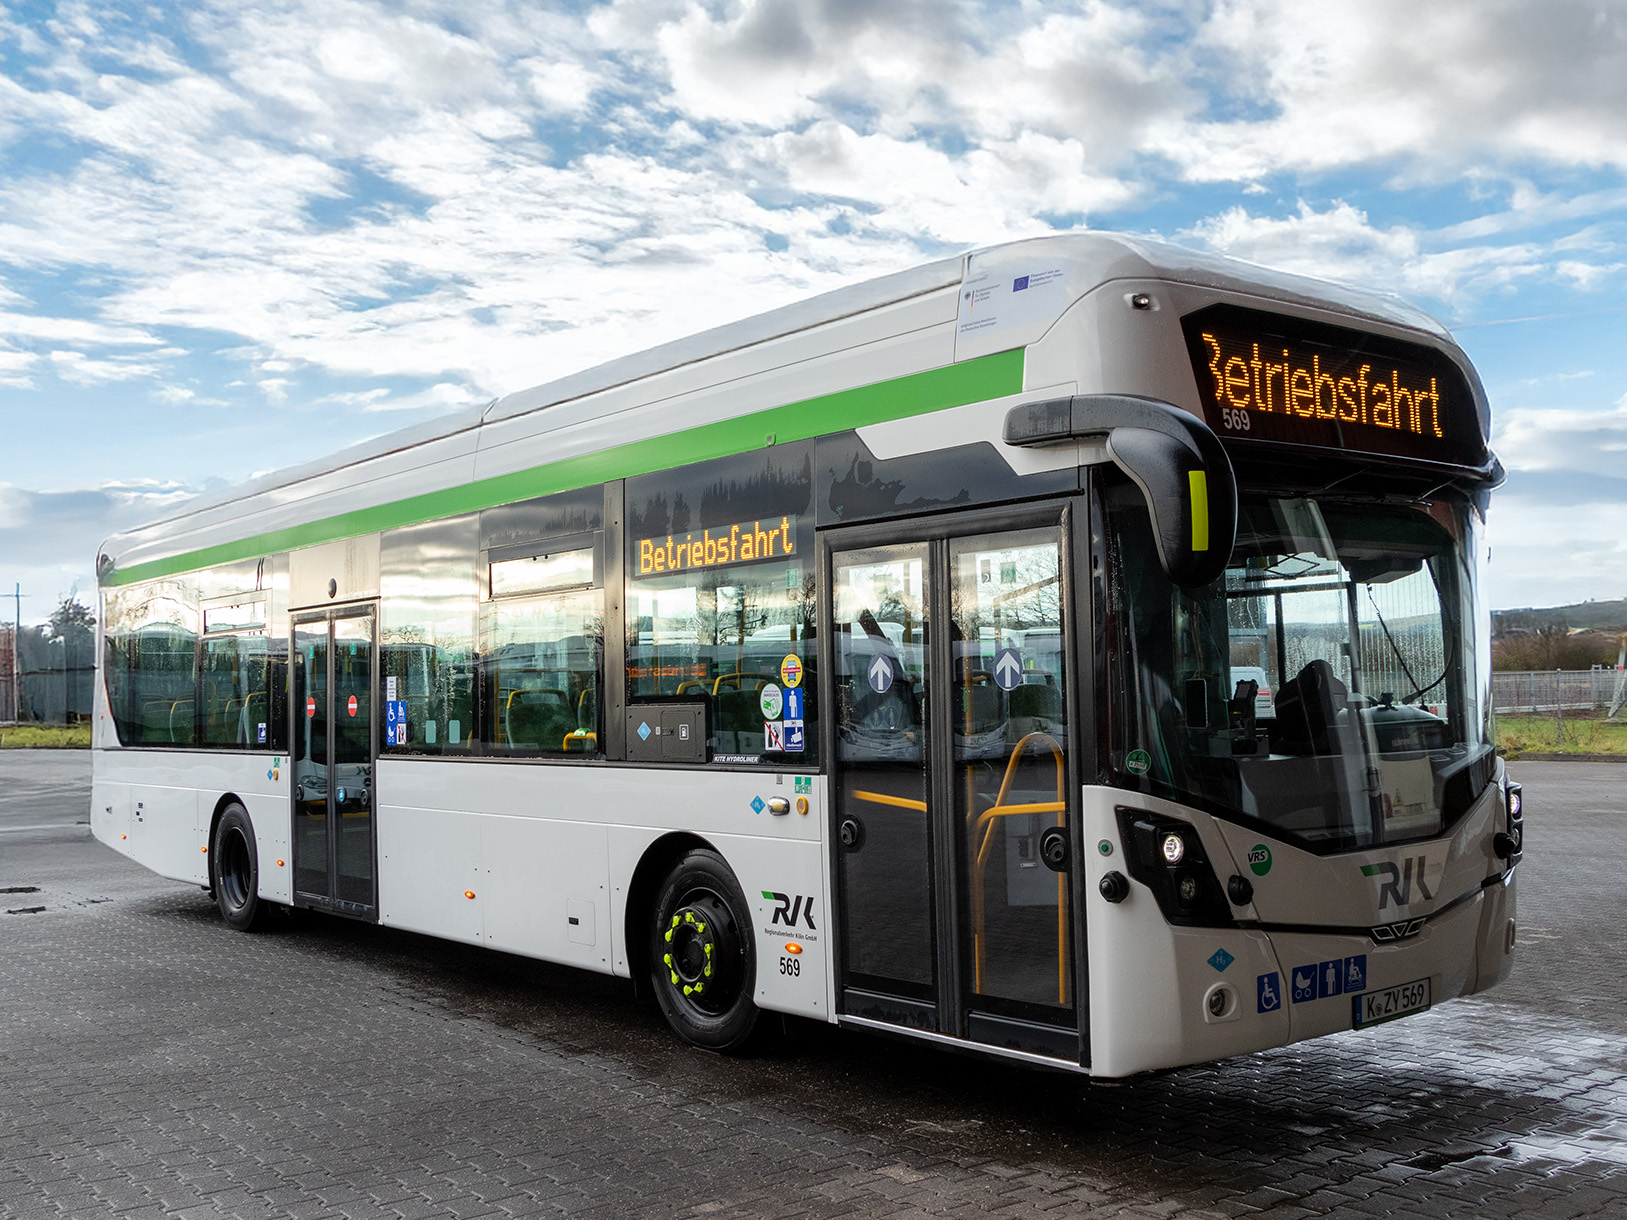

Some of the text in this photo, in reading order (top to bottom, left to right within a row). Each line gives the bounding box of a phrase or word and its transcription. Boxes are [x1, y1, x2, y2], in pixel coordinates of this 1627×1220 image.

[1222, 407, 1251, 431] 569
[640, 516, 794, 574] Betriebsfahrt
[1248, 851, 1266, 863] VRS
[764, 928, 795, 939] Regionalverkehr
[804, 934, 818, 942] GmbH
[779, 956, 801, 978] 569
[1367, 983, 1425, 1019] K ZY 569
